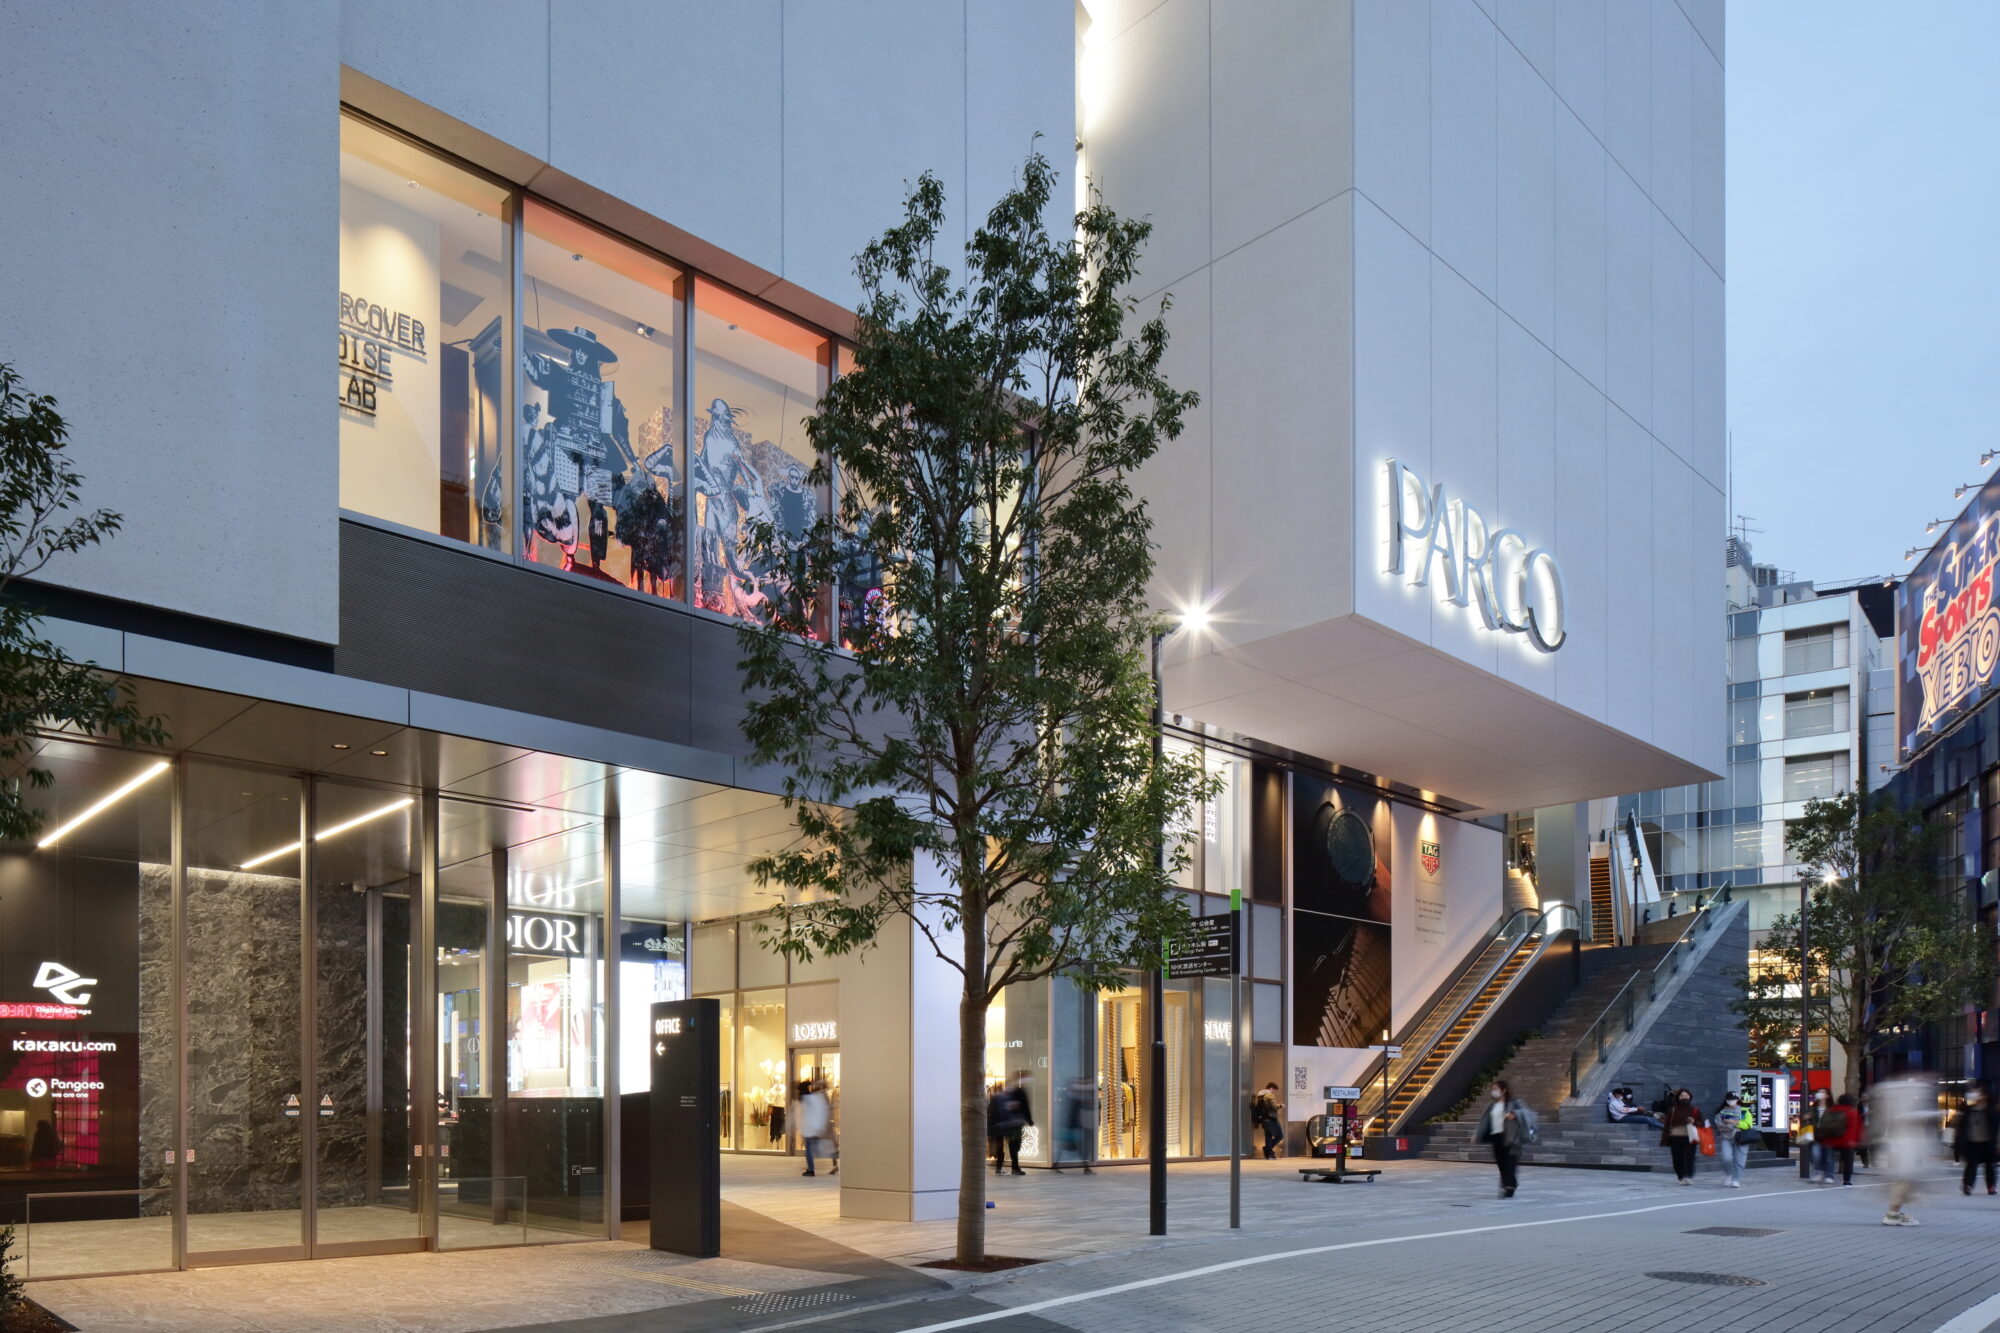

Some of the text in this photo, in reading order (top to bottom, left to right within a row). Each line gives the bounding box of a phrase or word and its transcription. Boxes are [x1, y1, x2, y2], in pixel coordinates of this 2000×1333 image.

[1385, 457, 1567, 654] PARCO
[1924, 517, 2000, 614] THE SUPER
[1918, 564, 1991, 668] SPORTS
[1920, 610, 2000, 729] XEBIO
[1423, 844, 1438, 856] TAG
[655, 1017, 680, 1034] OFFICE
[793, 1021, 837, 1041] LOEWE
[51, 1078, 104, 1092] Pangaea
